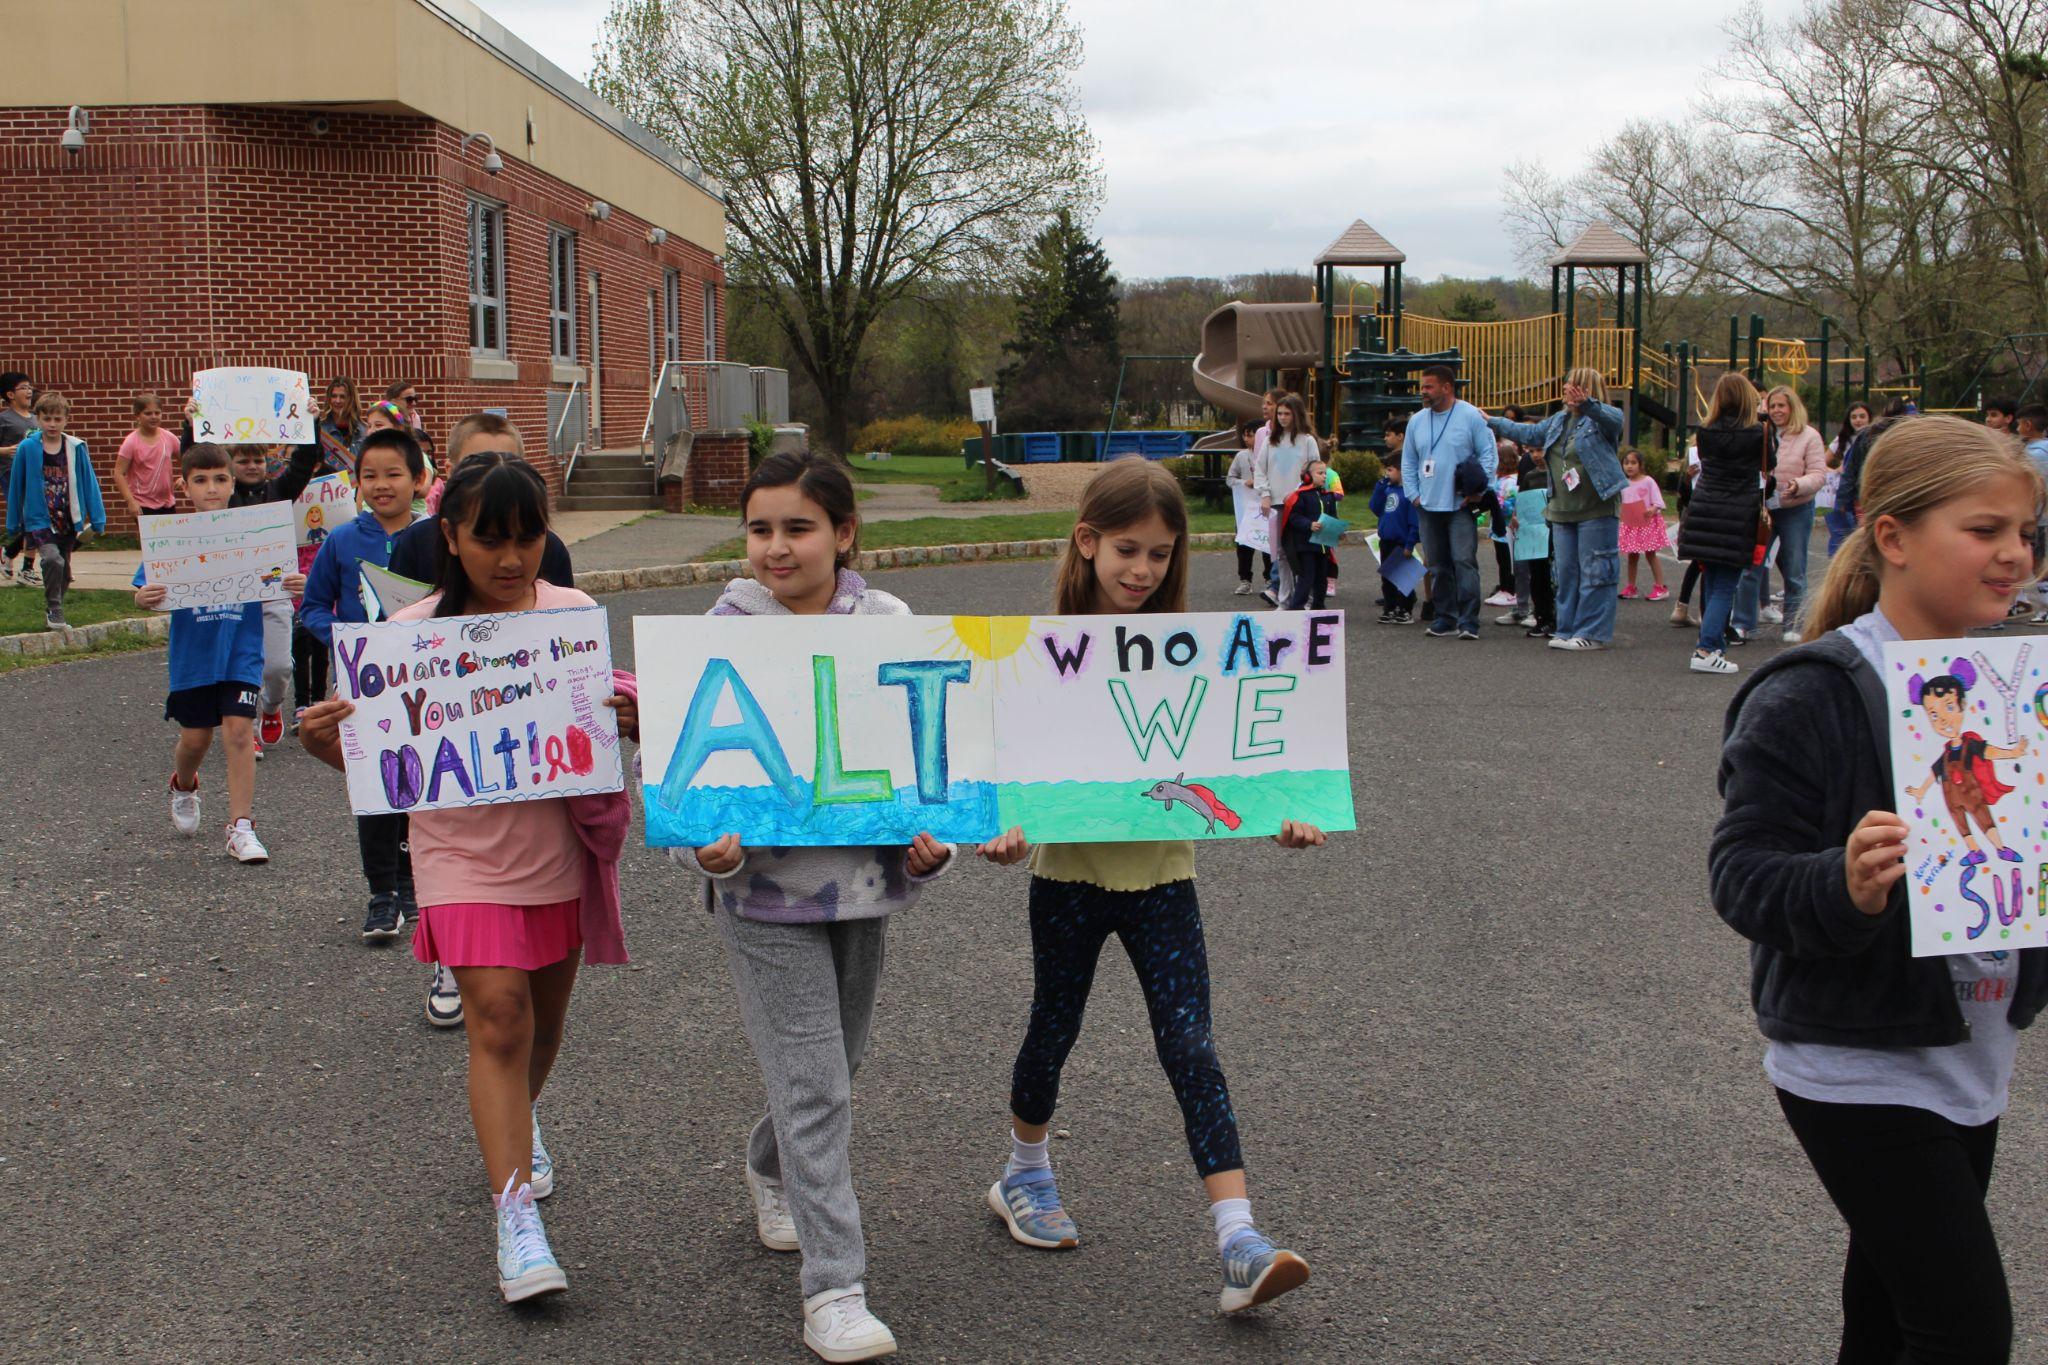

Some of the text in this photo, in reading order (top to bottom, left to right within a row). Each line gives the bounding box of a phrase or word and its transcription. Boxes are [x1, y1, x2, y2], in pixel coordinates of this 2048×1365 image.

[320, 482, 349, 503] Are
[338, 637, 408, 700] You
[413, 656, 450, 681] are
[550, 636, 599, 661] than
[400, 687, 464, 737] You
[656, 655, 972, 814] ALT
[1107, 675, 1297, 762] WE
